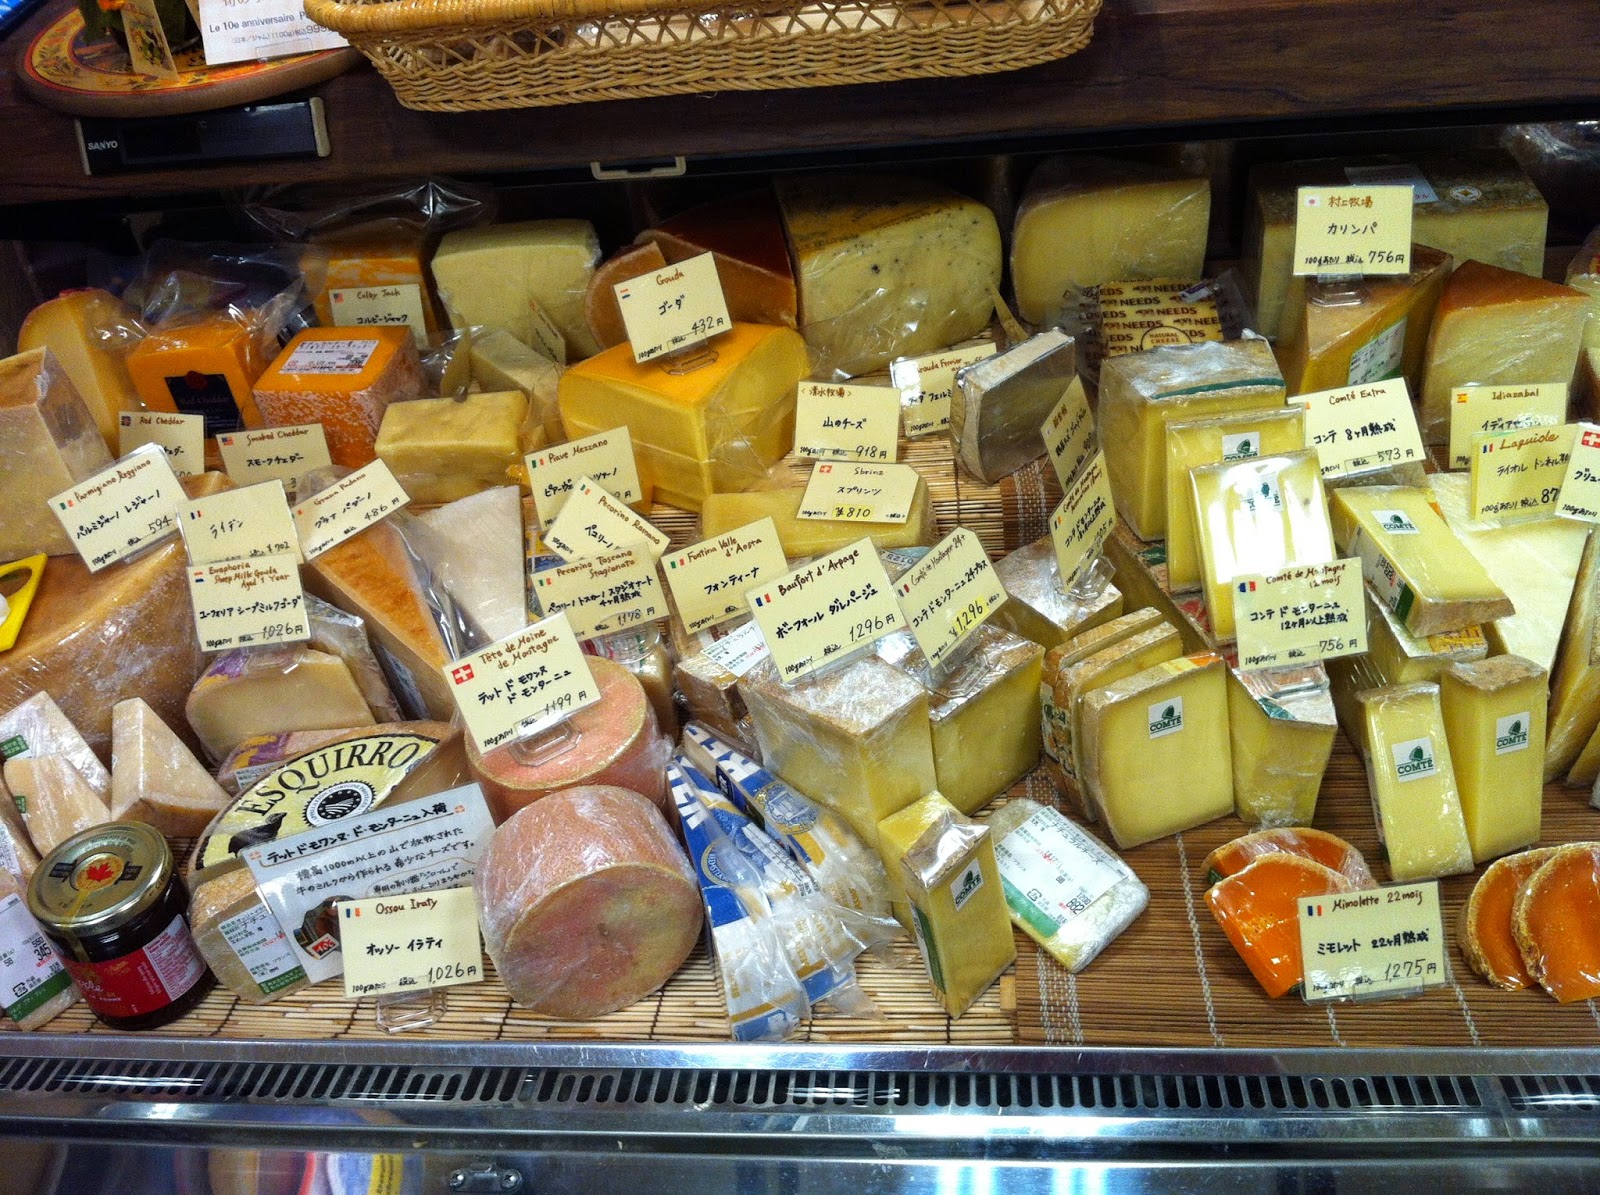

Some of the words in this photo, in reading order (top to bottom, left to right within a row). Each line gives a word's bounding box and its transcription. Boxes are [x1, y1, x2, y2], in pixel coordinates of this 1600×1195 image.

[209, 24, 220, 33] Le
[223, 22, 240, 30] 10e
[242, 14, 294, 28] anniversaire
[88, 140, 118, 152] SANYO
[1328, 196, 1374, 208] 村上牧場
[1327, 221, 1378, 234] カリンパ
[1368, 250, 1404, 264] 756円
[656, 268, 684, 286] Gouda
[356, 292, 377, 300] Colby
[381, 288, 400, 296] Jack
[1120, 296, 1160, 306] NEEDS
[659, 294, 685, 315] ゴーダ
[1156, 306, 1198, 316] NEEDS
[1122, 320, 1164, 329] NEEDS
[929, 389, 952, 402] フェルミ
[1329, 391, 1356, 405] Comté
[1360, 388, 1386, 398] Extra
[1492, 388, 1539, 400] Idiazabal
[138, 416, 152, 424] Red
[156, 416, 185, 426] Cheddar
[822, 416, 867, 430] 山のチーズ
[246, 432, 274, 446] Smoked
[277, 428, 309, 439] Cheddar
[1314, 430, 1337, 444] コンテ
[1499, 430, 1559, 450] Laguiole
[246, 453, 304, 467] スモークチェダー
[548, 452, 569, 464] Piave
[572, 439, 608, 457] Mezzano
[856, 446, 888, 460] 918円
[854, 466, 884, 476] Sbrinz
[1497, 463, 1528, 477] ライオル
[74, 477, 117, 503] Parmigiano
[117, 460, 151, 483] Reggiano
[339, 472, 366, 490] Padano
[837, 486, 882, 495] スプリンツ
[1541, 487, 1560, 504] 87
[77, 510, 120, 539] パルミジャーノ
[125, 489, 160, 513] レジャーノ
[598, 496, 630, 522] Pecorino
[632, 519, 660, 545] Romano
[148, 515, 172, 534] 594
[210, 518, 244, 538] ライデン
[584, 524, 614, 551] ペコリーノ
[688, 546, 718, 562] Fontina
[719, 536, 738, 551] Valle
[556, 562, 592, 577] Pecorino
[598, 550, 633, 566] Toscano
[589, 559, 636, 579] Stagionato
[214, 574, 233, 585] Sheep
[233, 571, 252, 582] Milk
[254, 567, 278, 578] Gouda
[241, 579, 257, 591] Aged
[268, 574, 290, 582] Year
[704, 567, 761, 596] フォンティーナ
[1266, 572, 1292, 584] Comté
[578, 592, 606, 606] トスカーノ
[200, 605, 234, 619] ユーフォリア
[776, 612, 825, 640] ボーフォール
[828, 583, 879, 614] ダルパージュ
[1250, 609, 1275, 621] コンテ
[1280, 606, 1289, 618] ド
[1292, 602, 1341, 616] モンターニュ
[479, 650, 503, 664] Tête
[505, 643, 516, 654] de
[517, 629, 547, 650] Moine
[497, 659, 509, 670] de
[512, 635, 559, 666] Montagne
[478, 687, 502, 705] テット
[505, 679, 514, 692] ド
[507, 693, 516, 704] ド
[521, 670, 572, 697] モンターニュ
[410, 898, 438, 910] Iraty
[1332, 896, 1379, 912] Mimolette
[366, 943, 400, 956] オッソー
[407, 937, 443, 951] イラティ
[1317, 939, 1361, 955] ミモレット
